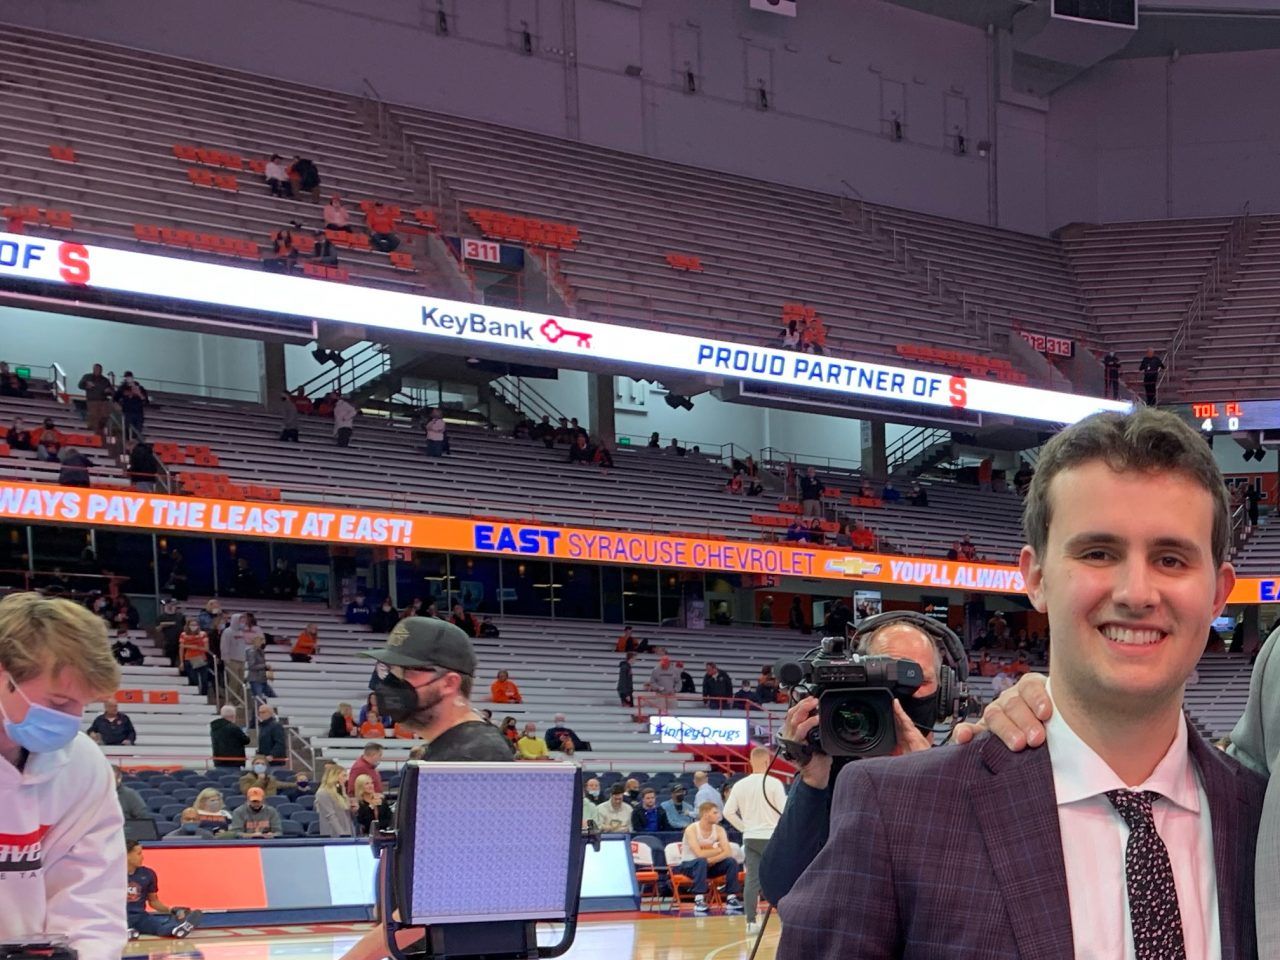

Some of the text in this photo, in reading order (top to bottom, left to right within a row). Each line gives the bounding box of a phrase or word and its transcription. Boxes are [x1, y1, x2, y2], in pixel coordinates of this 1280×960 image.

[0, 240, 91, 285] OF S
[467, 241, 498, 261] 311
[421, 306, 534, 340] KeyBank
[1047, 339, 1070, 355] 313
[698, 345, 967, 408] PROUD PARTNER OF S
[1193, 403, 1219, 418] TOL
[1225, 402, 1243, 416] FL
[1201, 417, 1239, 431] 4 0
[86, 493, 144, 523] PAY
[150, 498, 206, 528] THE
[210, 504, 299, 535] LEAST
[301, 512, 335, 537] AT
[339, 515, 412, 543] EAST!
[474, 524, 1026, 591] EAST SYRACUSE CHEVROLET YOU'LL ALWAYS
